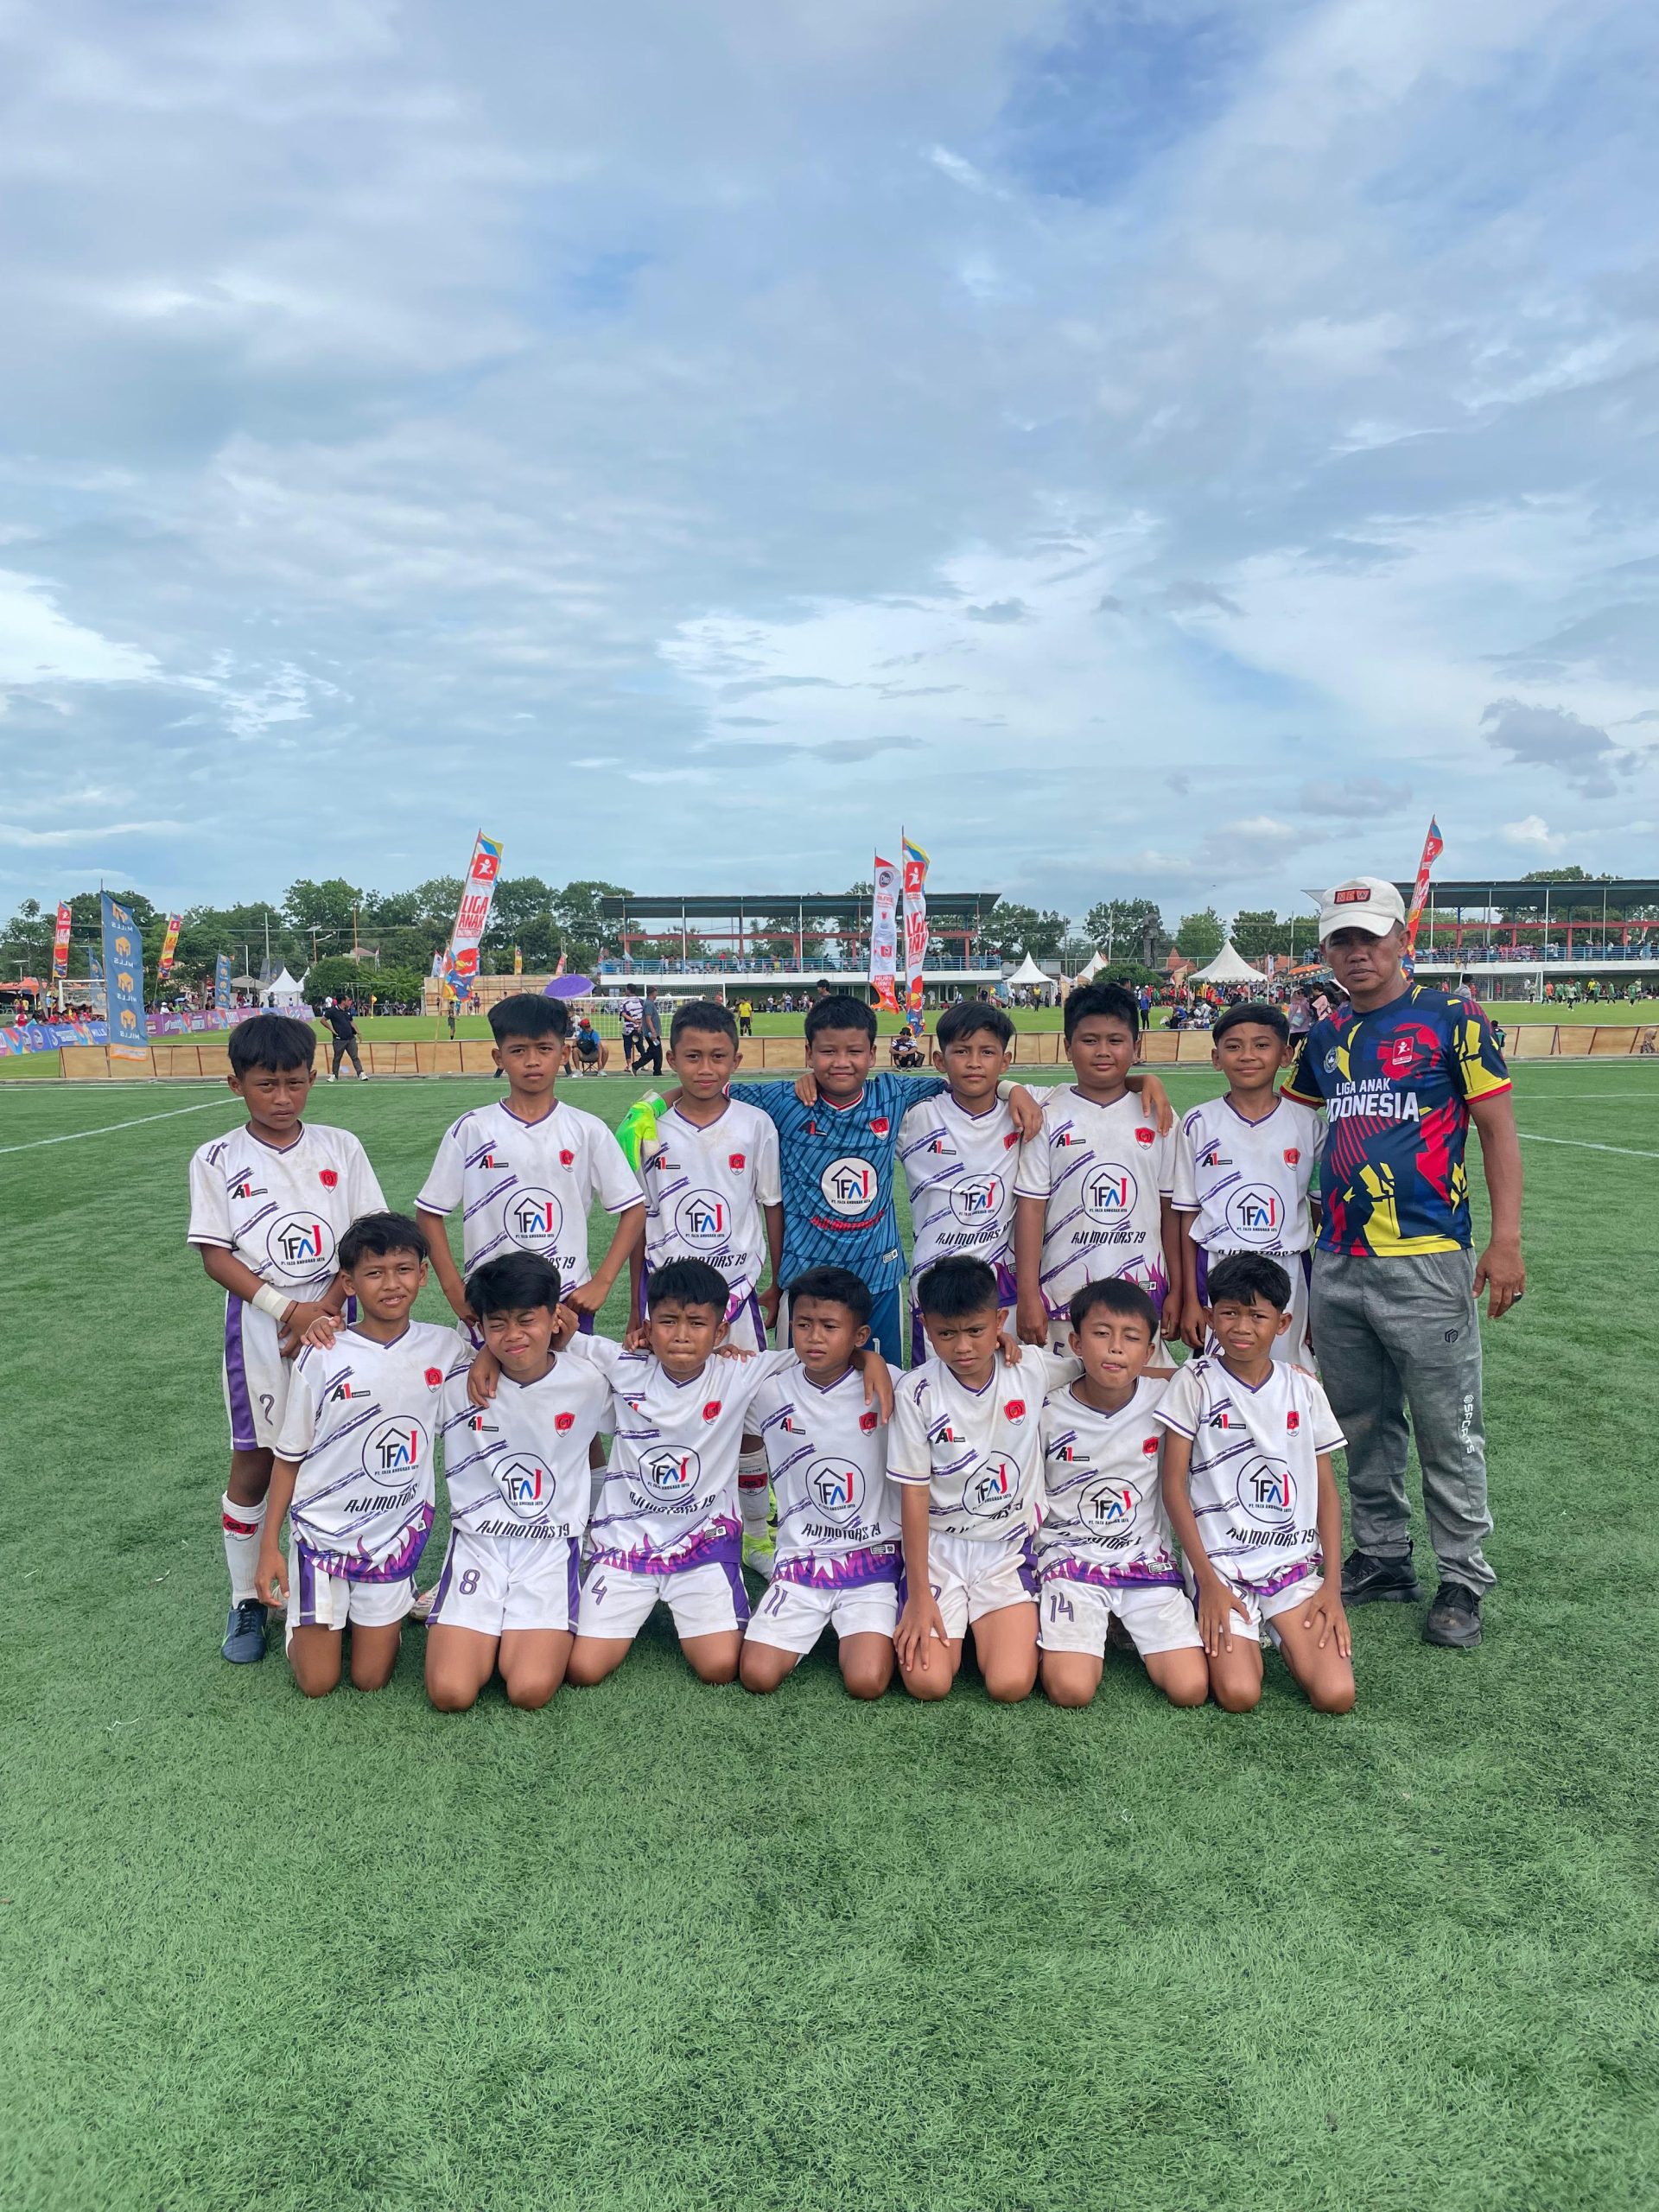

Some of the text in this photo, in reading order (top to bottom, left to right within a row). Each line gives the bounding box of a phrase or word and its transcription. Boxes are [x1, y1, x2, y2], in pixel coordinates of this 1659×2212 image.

[461, 895, 489, 914] LIGA
[1336, 890, 1370, 902] NEW
[458, 914, 485, 930] ANAK
[1336, 1077, 1391, 1096] LIGA ANAK
[954, 1229, 1001, 1246] MOTORS
[1071, 1230, 1147, 1246] AJI MOTORS 79
[563, 1256, 575, 1269] 79
[735, 1252, 747, 1266] 79
[343, 1496, 372, 1513] AJI
[475, 1518, 570, 1540] AJI MOTORS 79
[801, 1522, 822, 1539] AJI
[821, 1524, 868, 1542] MOTORS
[1247, 1528, 1300, 1548] MOTORS
[1300, 1529, 1316, 1544] 79
[459, 1568, 480, 1595] 8
[591, 1574, 607, 1605] 4
[1051, 1592, 1075, 1623] 14
